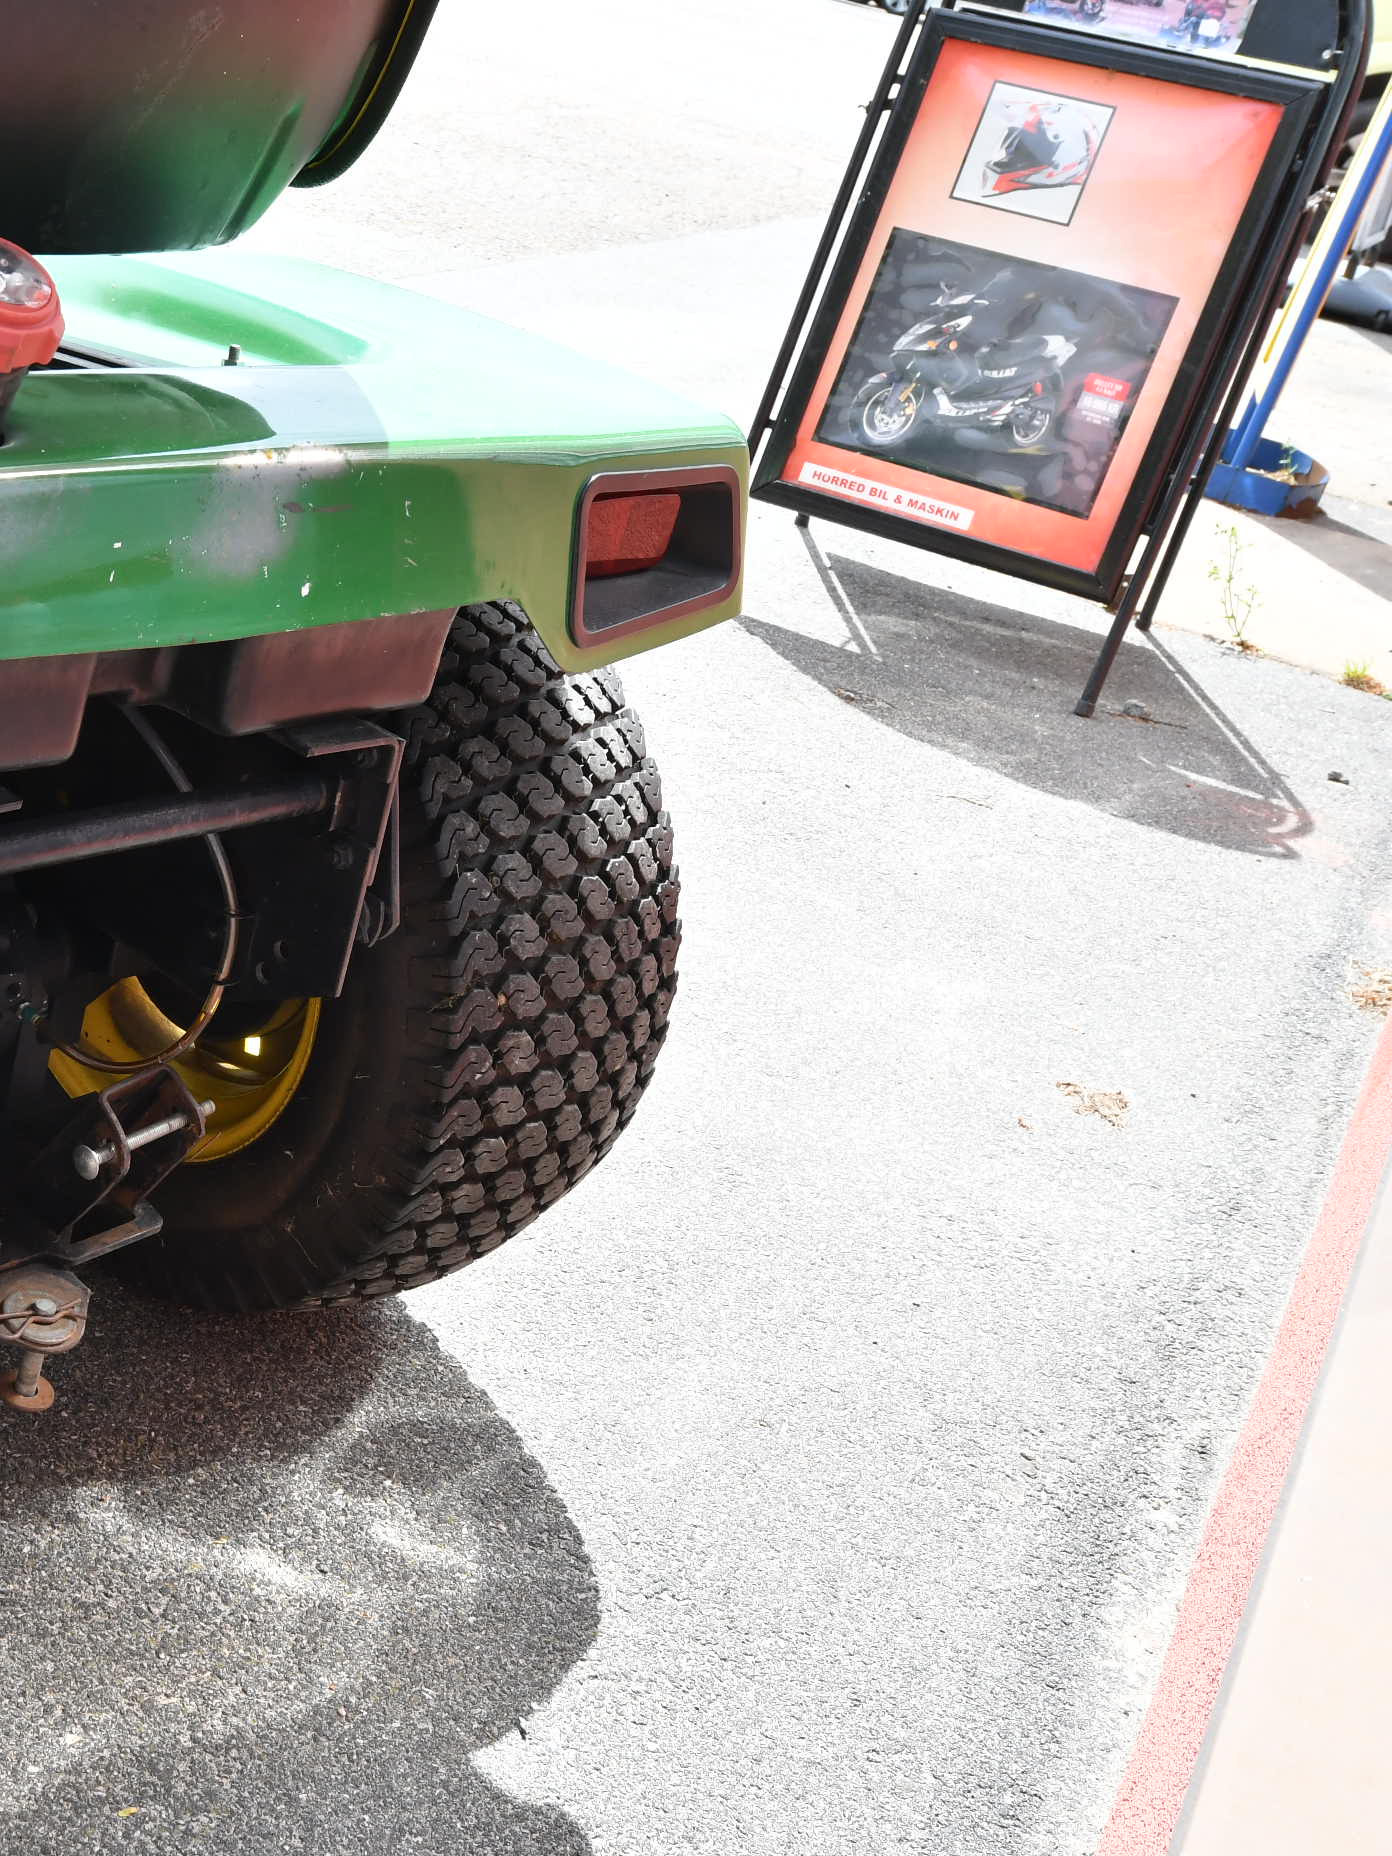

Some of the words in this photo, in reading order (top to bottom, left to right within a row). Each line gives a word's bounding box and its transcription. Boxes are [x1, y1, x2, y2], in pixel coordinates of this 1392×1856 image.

[812, 470, 865, 493] HORRED
[869, 487, 889, 501] BIL
[894, 494, 904, 505] &
[908, 498, 960, 521] MASKIN
